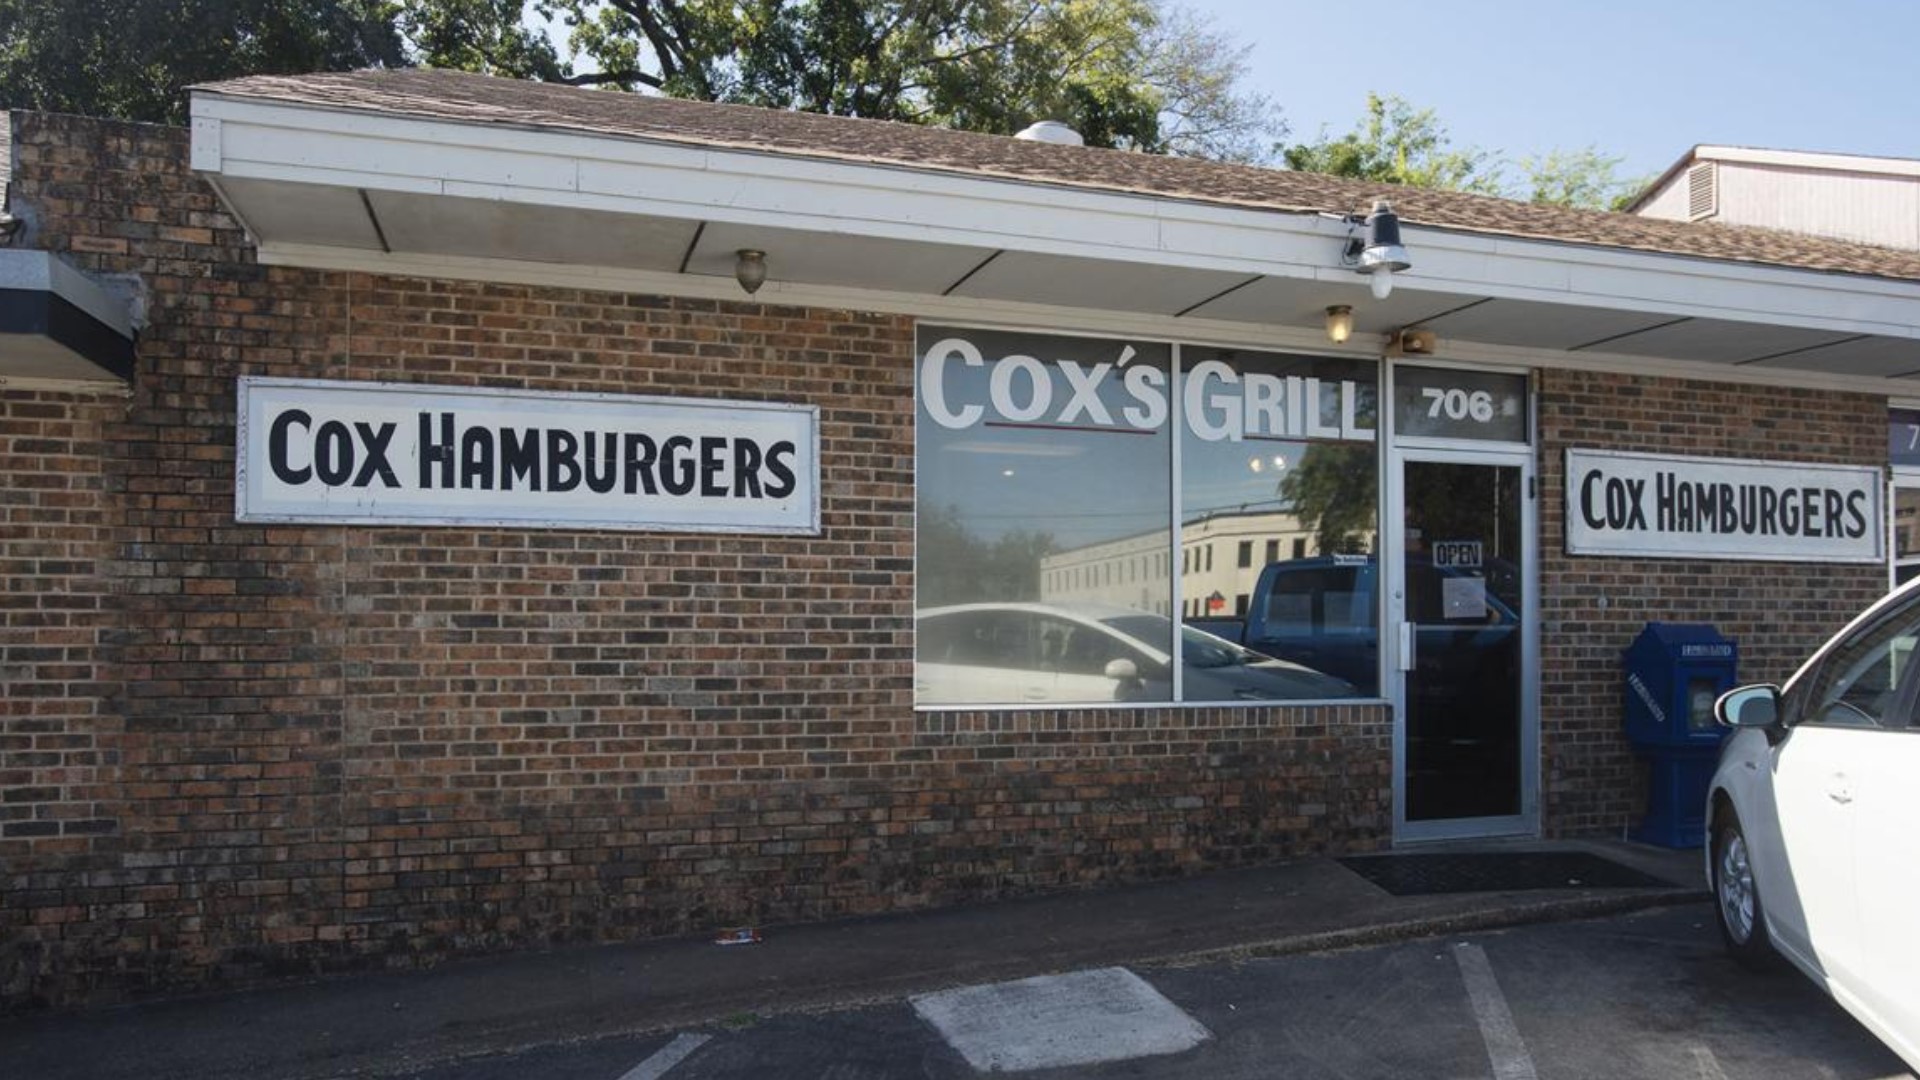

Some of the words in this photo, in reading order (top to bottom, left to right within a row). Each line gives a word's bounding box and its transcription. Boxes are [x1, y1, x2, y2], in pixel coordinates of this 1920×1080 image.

[919, 337, 1168, 430] COX'S
[1184, 360, 1376, 443] GRILL
[1422, 386, 1494, 423] 706
[267, 408, 402, 489] COX
[418, 411, 797, 499] HAMBURGERS
[1580, 468, 1648, 532] COX
[1656, 472, 1868, 540] HAMBURGERS
[1437, 544, 1480, 565] OPEN
